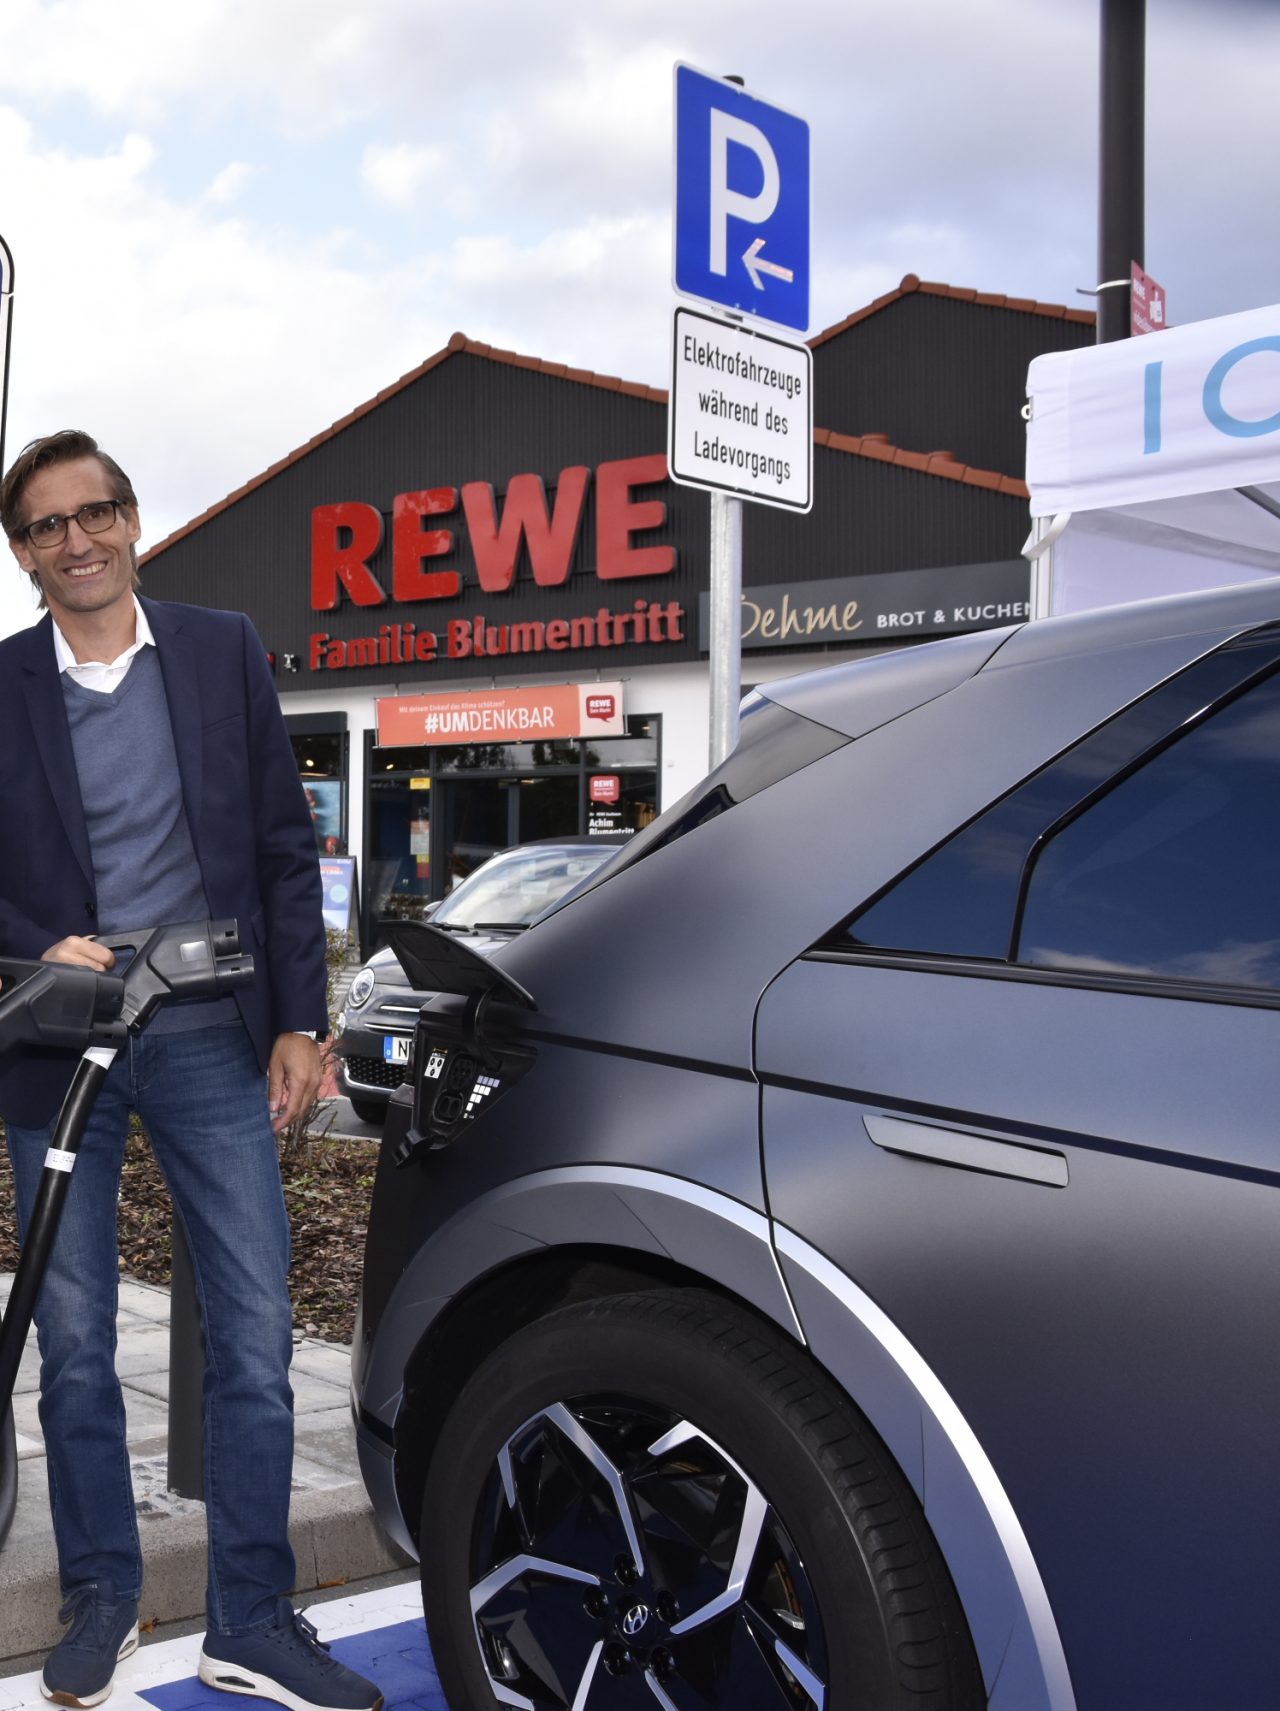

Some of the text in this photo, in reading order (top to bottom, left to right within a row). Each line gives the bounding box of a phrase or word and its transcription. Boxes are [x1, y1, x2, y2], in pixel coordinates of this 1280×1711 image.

[710, 106, 780, 277] P
[684, 335, 802, 399] Elektrofahrzeuge
[698, 389, 789, 435] während des
[694, 430, 791, 485] Ladevorgangs
[310, 453, 678, 611] REWE
[309, 599, 685, 671] Familie Blumentritt
[877, 609, 926, 629] BROT
[933, 609, 946, 624] &
[424, 706, 556, 734] #UMDENKBAR
[590, 699, 611, 707] REWE
[589, 818, 614, 828] Achim
[398, 1040, 408, 1057] N
